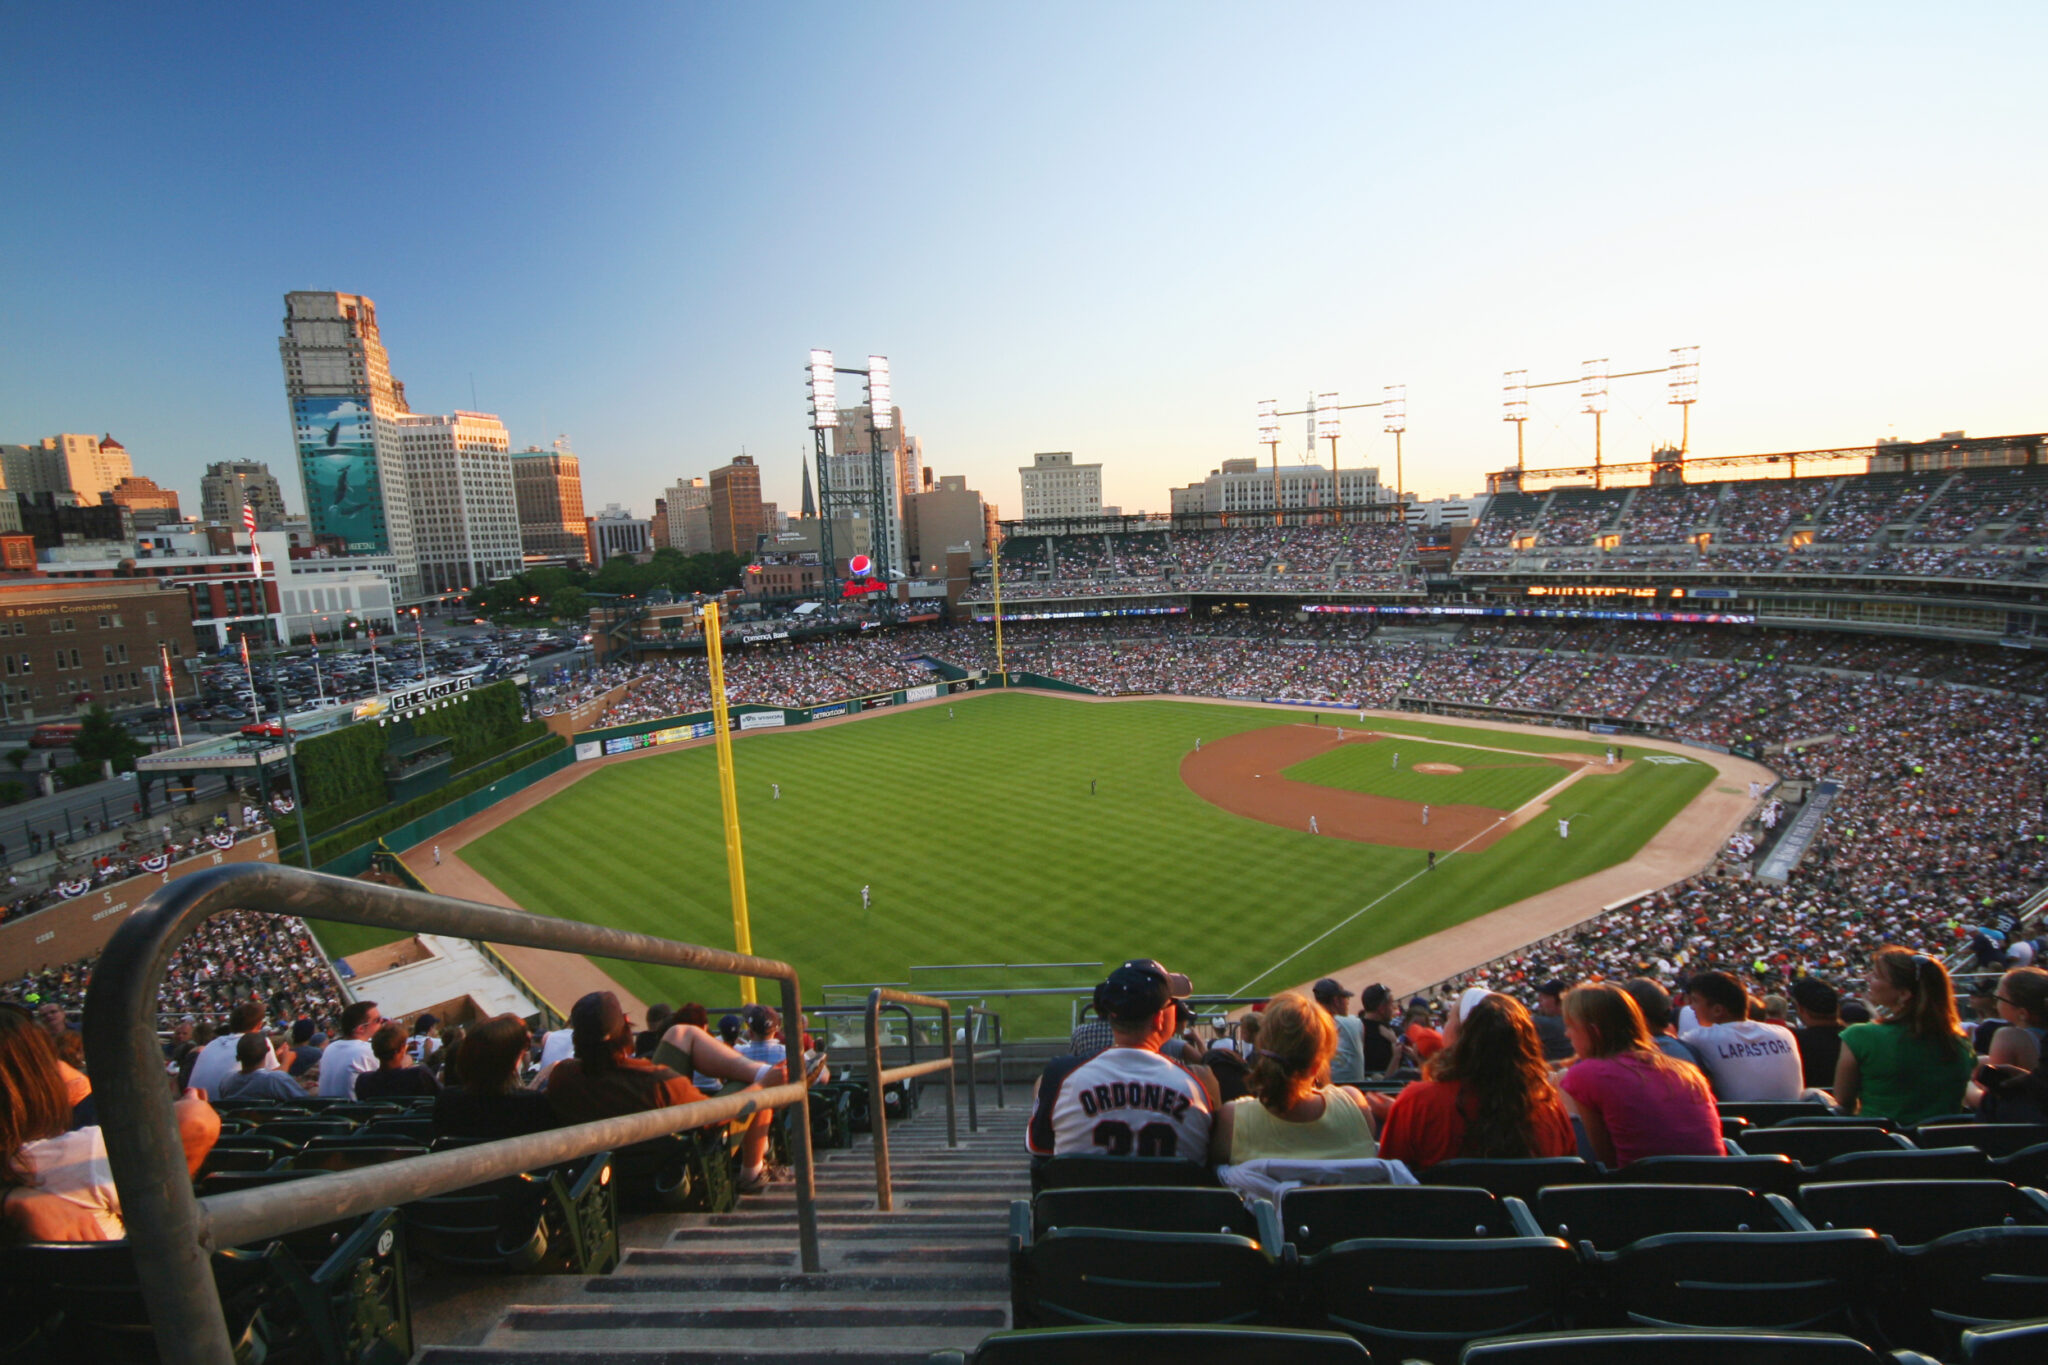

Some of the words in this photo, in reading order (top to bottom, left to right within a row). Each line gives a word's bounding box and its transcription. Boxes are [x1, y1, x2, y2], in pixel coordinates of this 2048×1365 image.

[17, 607, 57, 617] Barden
[60, 602, 120, 614] Companies
[773, 631, 789, 640] Bank
[392, 675, 475, 711] CHEVROLET
[212, 852, 223, 865] 16
[162, 872, 170, 884] 2
[103, 891, 112, 904] 5
[1079, 1081, 1192, 1123] ORDONEZ
